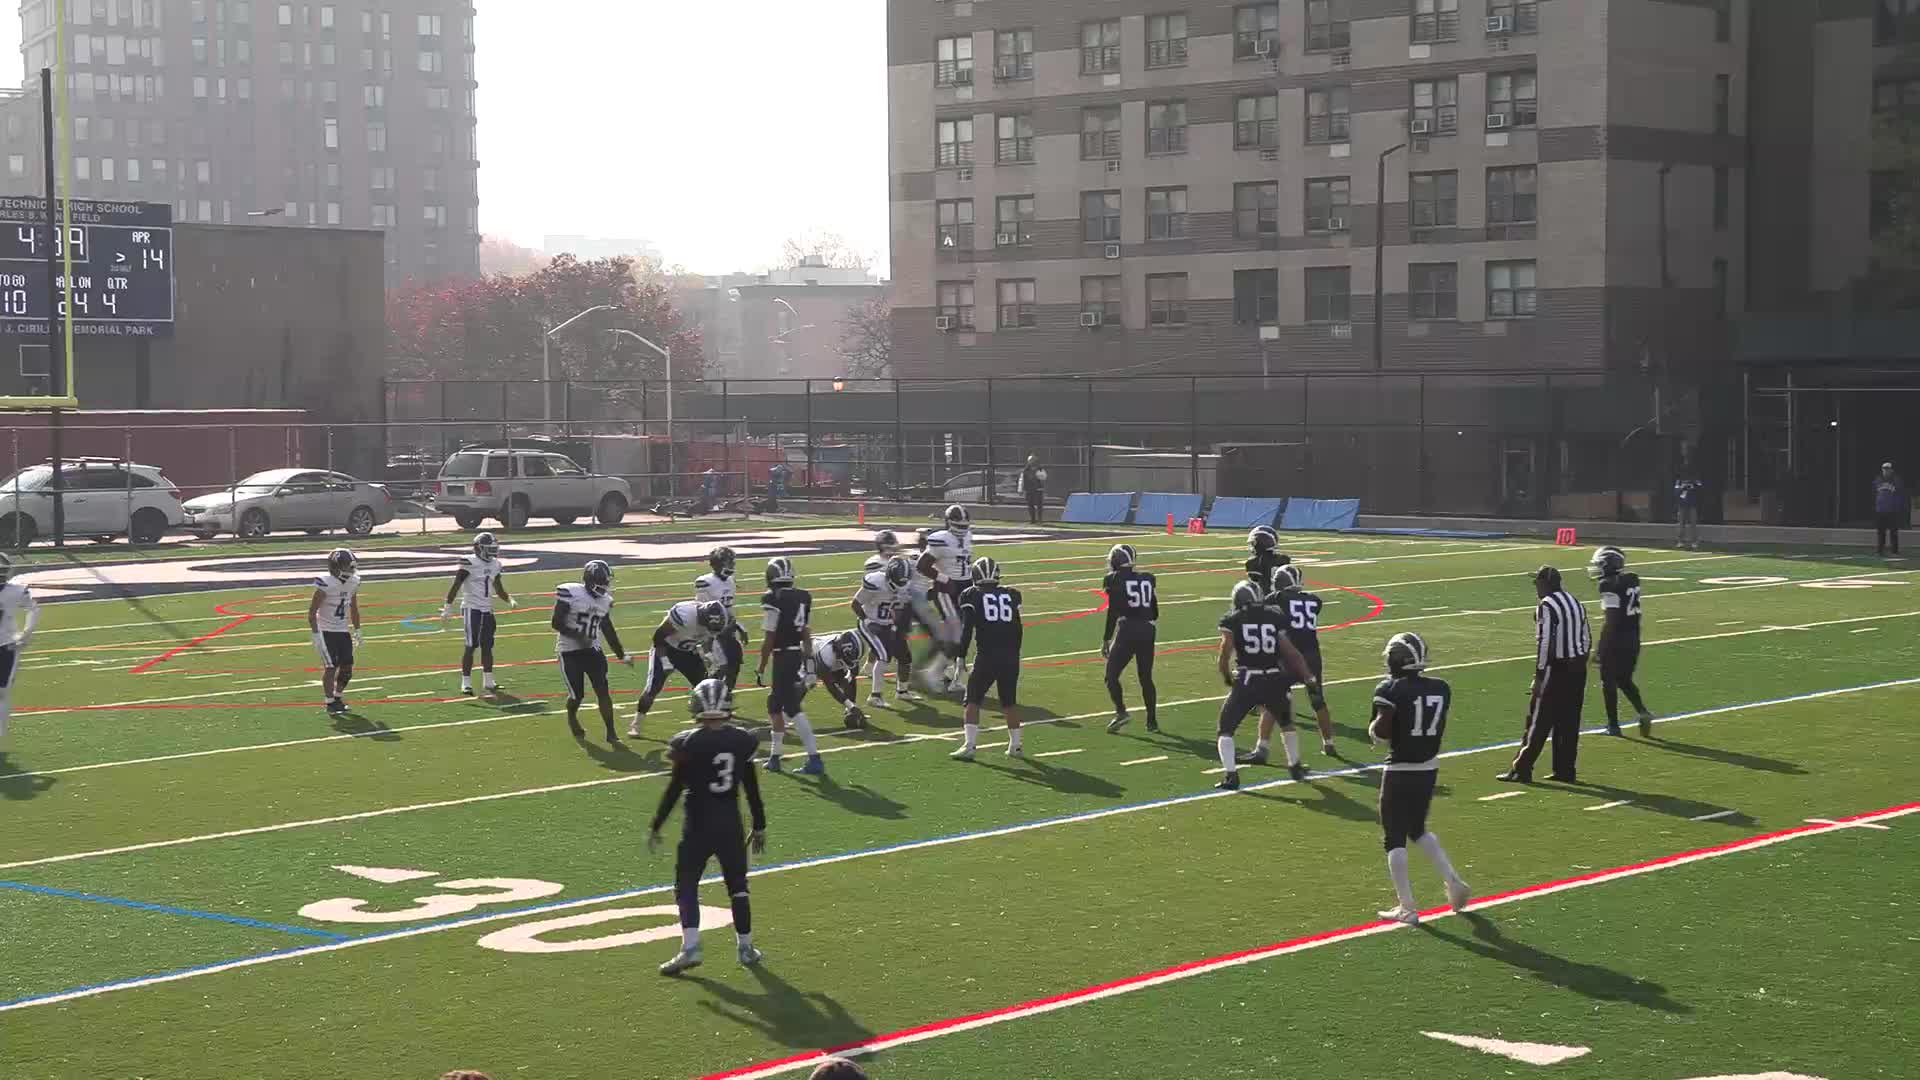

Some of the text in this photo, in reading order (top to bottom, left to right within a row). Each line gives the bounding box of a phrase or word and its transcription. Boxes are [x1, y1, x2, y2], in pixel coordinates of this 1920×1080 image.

[73, 213, 101, 223] FIELD
[97, 203, 144, 214] SCHOOL
[142, 249, 163, 269] 14
[12, 275, 25, 287] GO
[78, 277, 92, 289] ON
[107, 277, 128, 289] QTR
[4, 290, 27, 314] 10
[103, 294, 116, 314] 4
[73, 325, 122, 335] EMORIAL
[125, 326, 154, 335] PARK
[1126, 580, 1152, 608] 50
[334, 598, 345, 620] 4
[793, 603, 805, 632] 4
[983, 594, 1013, 622] 66
[1289, 600, 1317, 630] 55
[1242, 624, 1277, 654] 56
[1411, 696, 1444, 737] 17
[709, 753, 735, 793] 3
